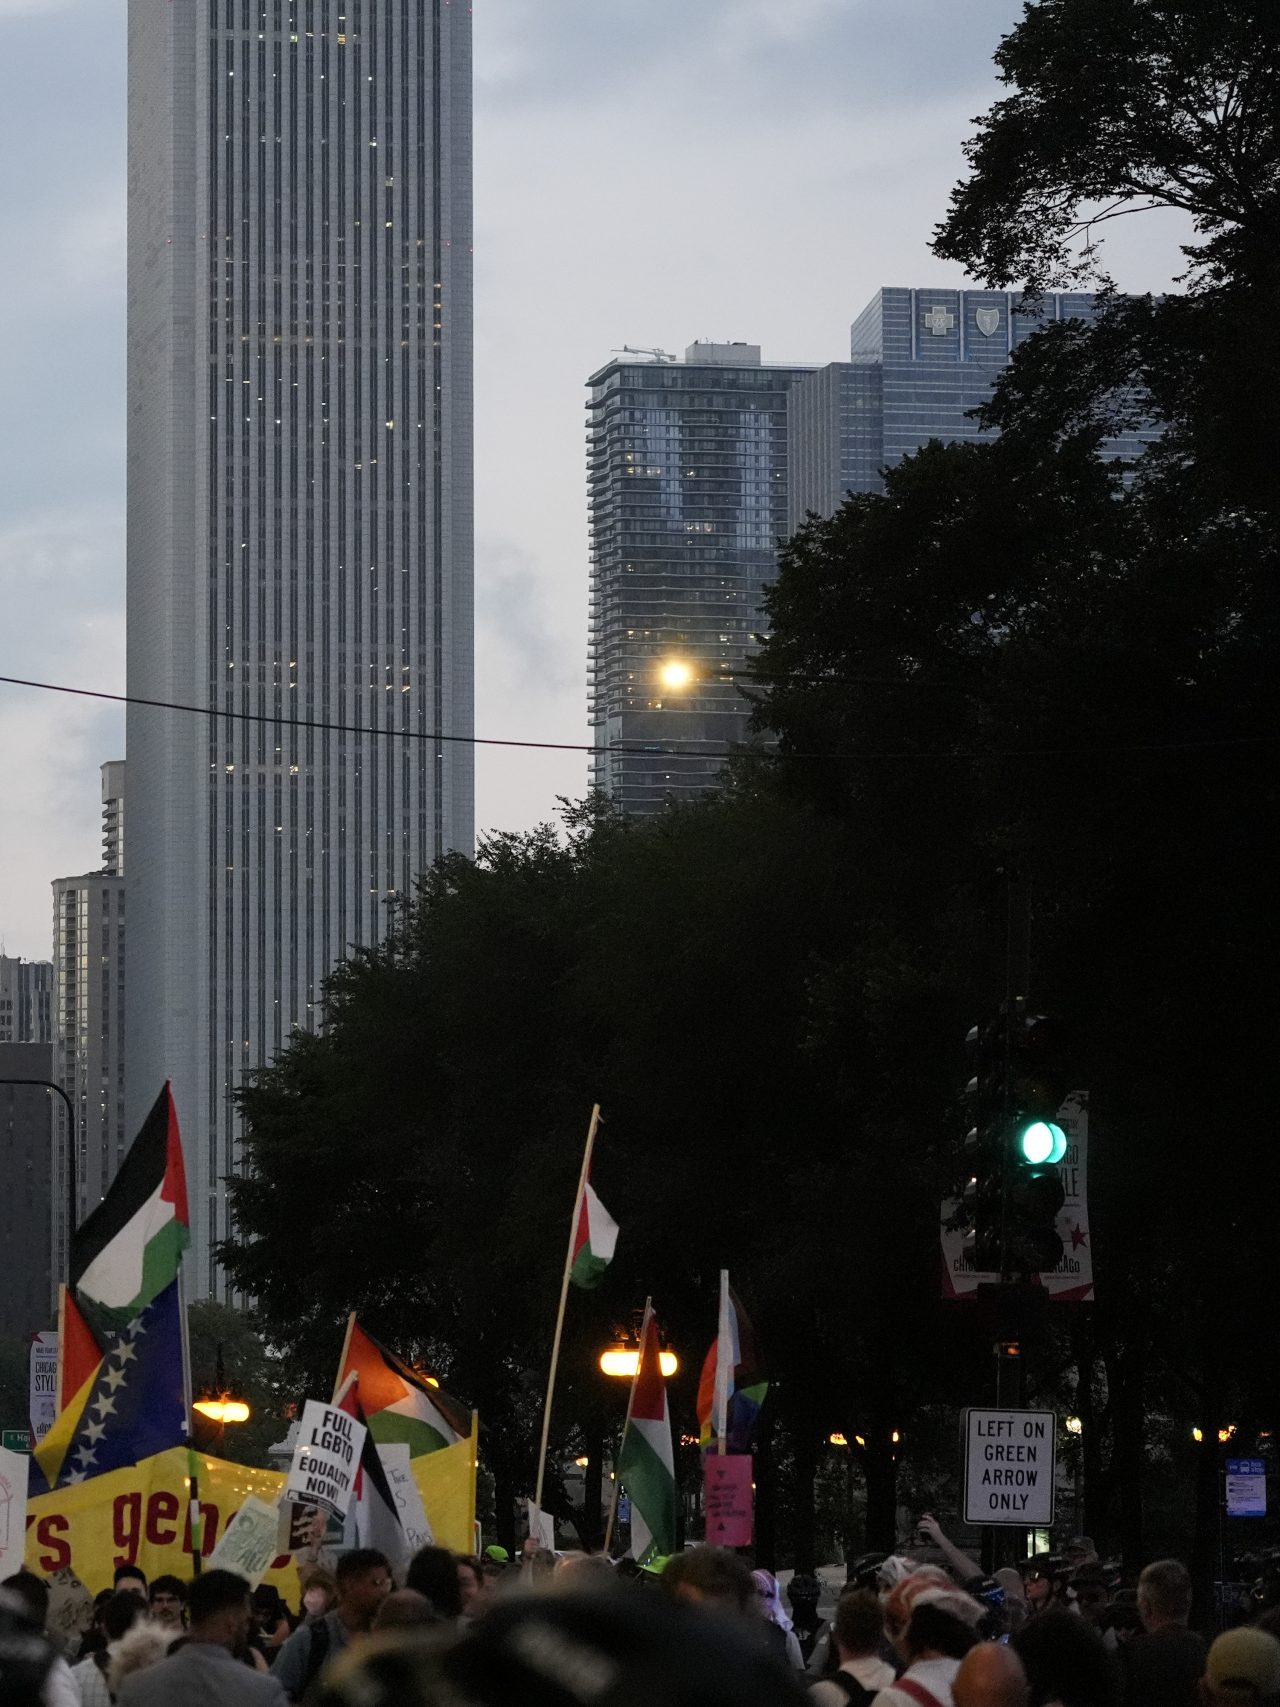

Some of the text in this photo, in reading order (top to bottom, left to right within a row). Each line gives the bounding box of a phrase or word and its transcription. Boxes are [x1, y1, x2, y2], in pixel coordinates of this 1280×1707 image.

[322, 1410, 353, 1442] FULL
[977, 1420, 1045, 1439] LEFT ON
[310, 1427, 354, 1467] LGBTQ
[984, 1444, 1037, 1463] GREEN
[298, 1455, 351, 1492] EQUALITY
[981, 1468, 1038, 1487] ARROW
[988, 1492, 1029, 1511] ONLY
